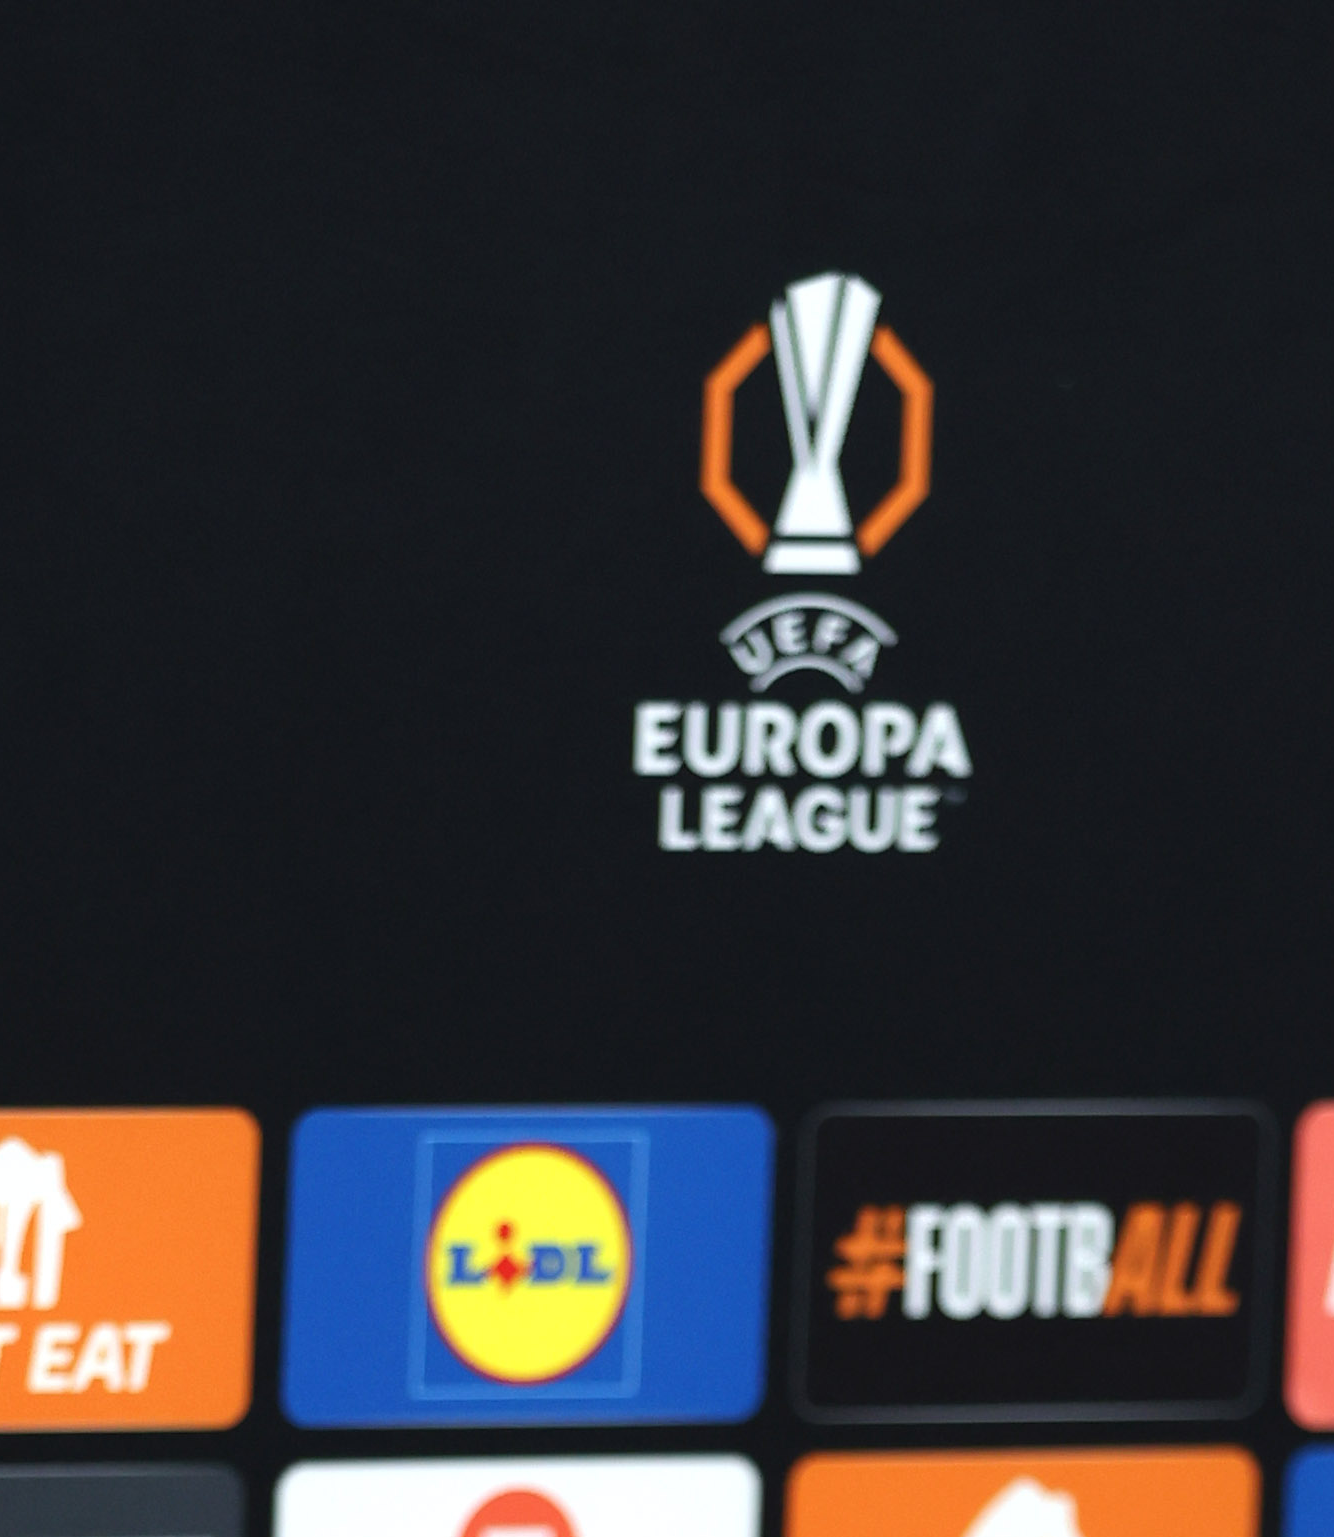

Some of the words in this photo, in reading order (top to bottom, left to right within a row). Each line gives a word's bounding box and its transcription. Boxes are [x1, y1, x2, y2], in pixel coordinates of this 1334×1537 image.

[633, 702, 972, 778] EUROPA
[658, 785, 940, 853] LEAGUE
[828, 1202, 1241, 1319] #FOOTBALL
[27, 1322, 172, 1393] EAT
